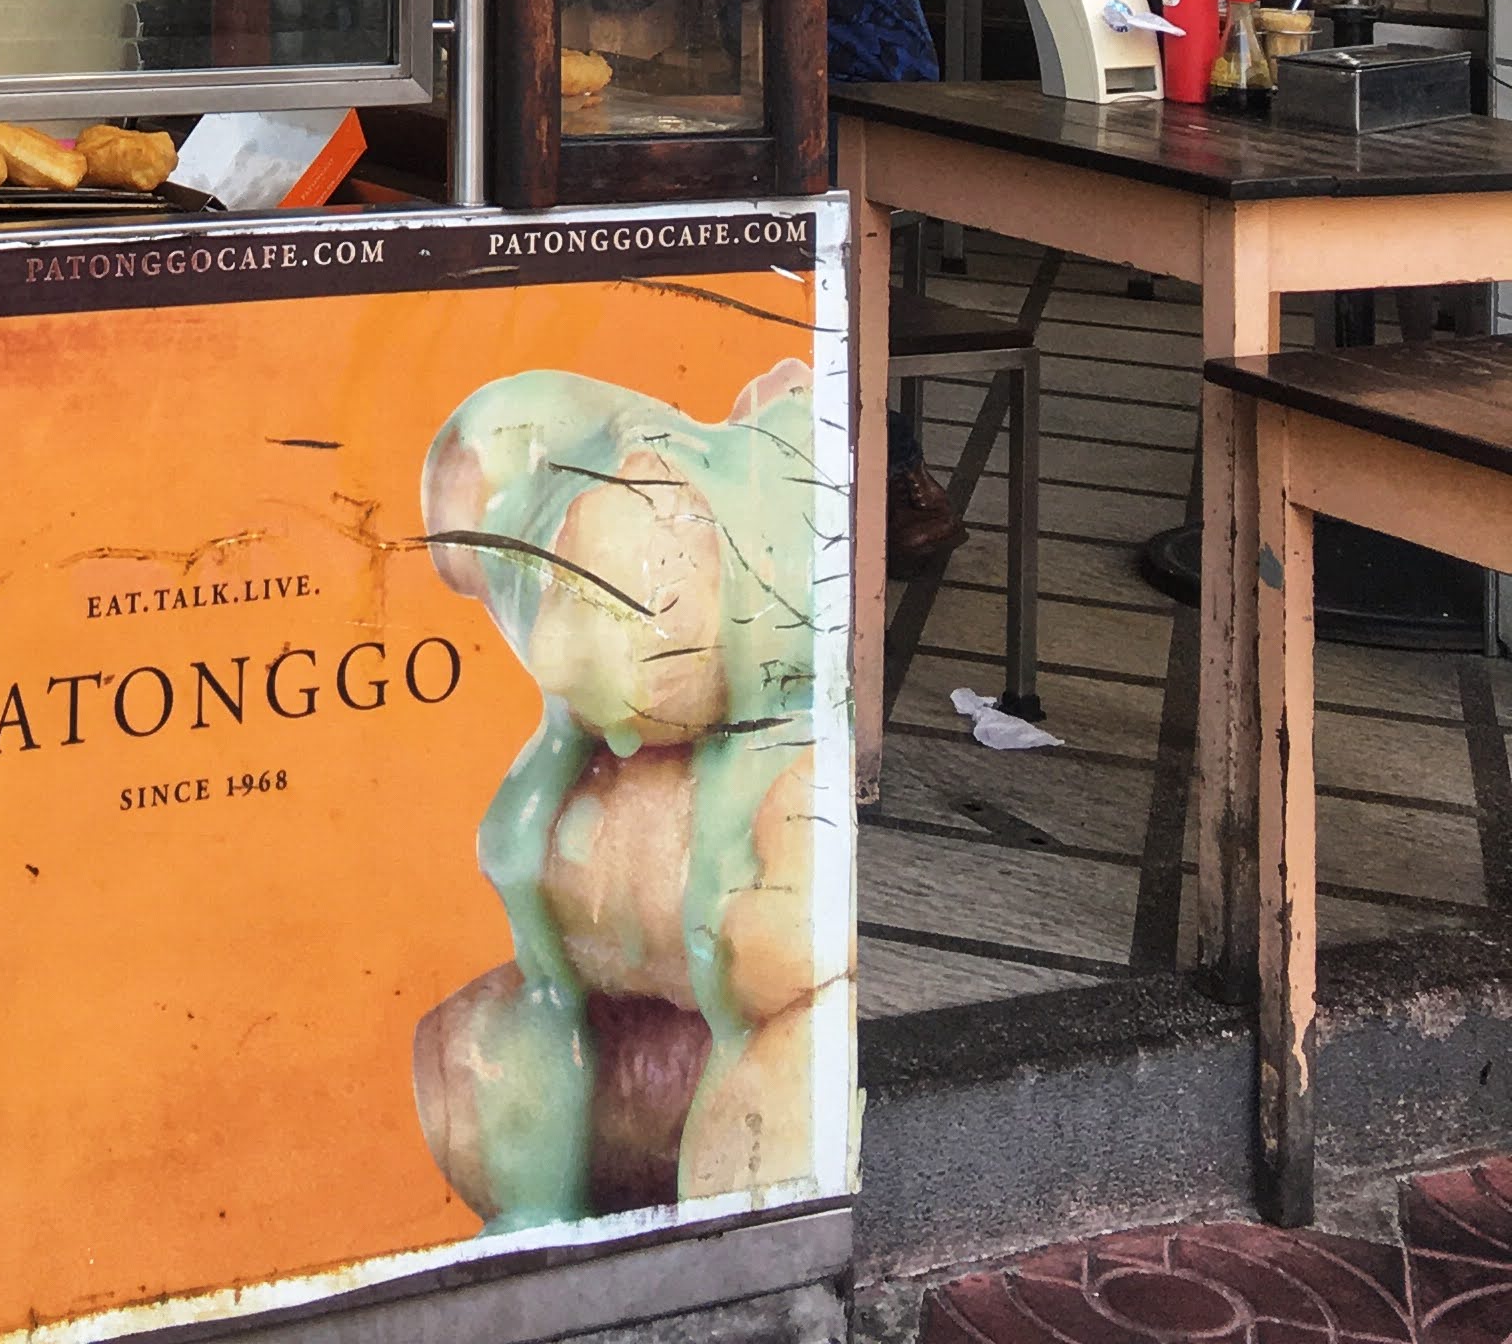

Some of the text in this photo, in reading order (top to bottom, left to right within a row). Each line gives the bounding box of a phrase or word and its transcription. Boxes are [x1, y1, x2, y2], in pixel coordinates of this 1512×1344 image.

[488, 220, 809, 258] PATONGGOCAFE.COM
[25, 239, 385, 284] PATONGGOCAFE.COM
[87, 574, 320, 619] EAT.TALK.LIVE.
[119, 769, 289, 811] SINCE 1968
